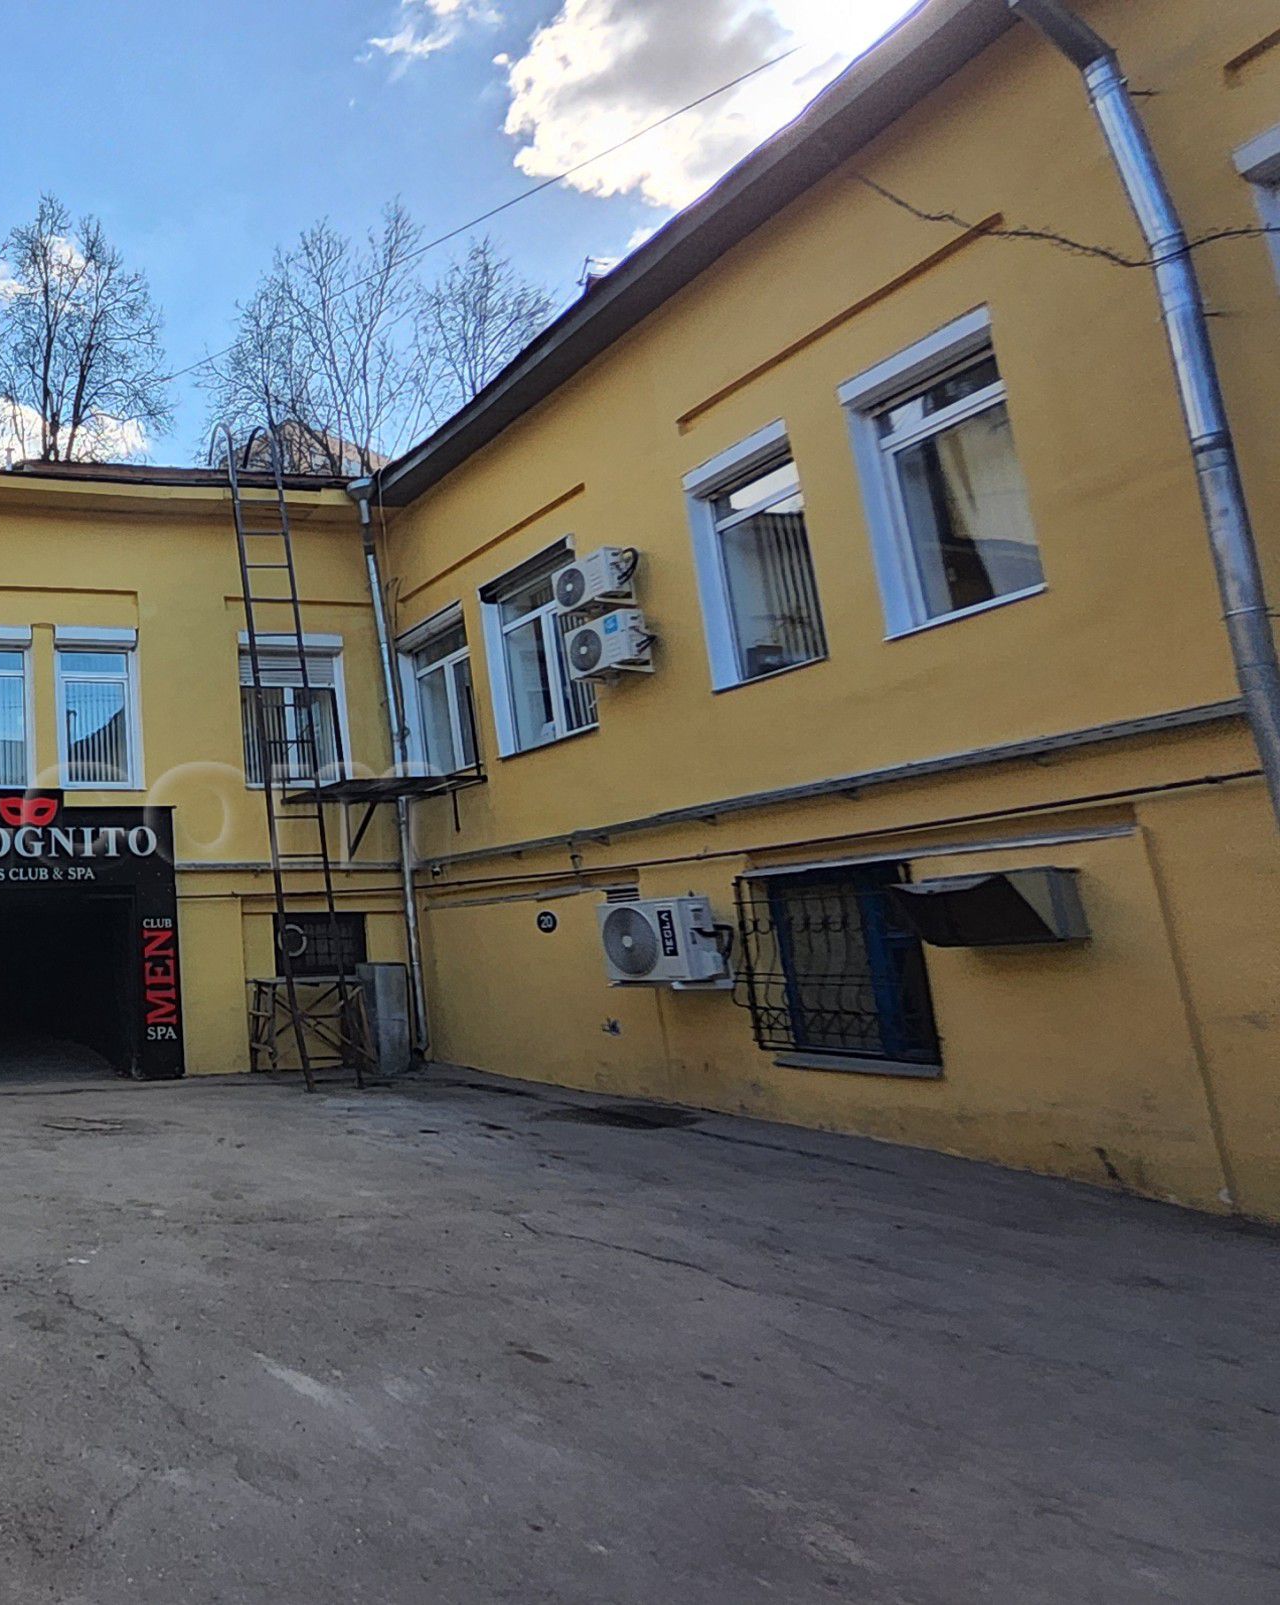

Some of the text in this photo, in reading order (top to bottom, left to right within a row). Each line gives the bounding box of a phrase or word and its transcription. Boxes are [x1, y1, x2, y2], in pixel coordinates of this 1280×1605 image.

[8, 867, 49, 881] CLUB
[52, 868, 63, 881] &
[67, 867, 96, 881] SPA
[142, 918, 173, 929] CLUB
[539, 915, 554, 929] 20
[143, 929, 177, 1025] MEN
[147, 1026, 177, 1041] SPA
